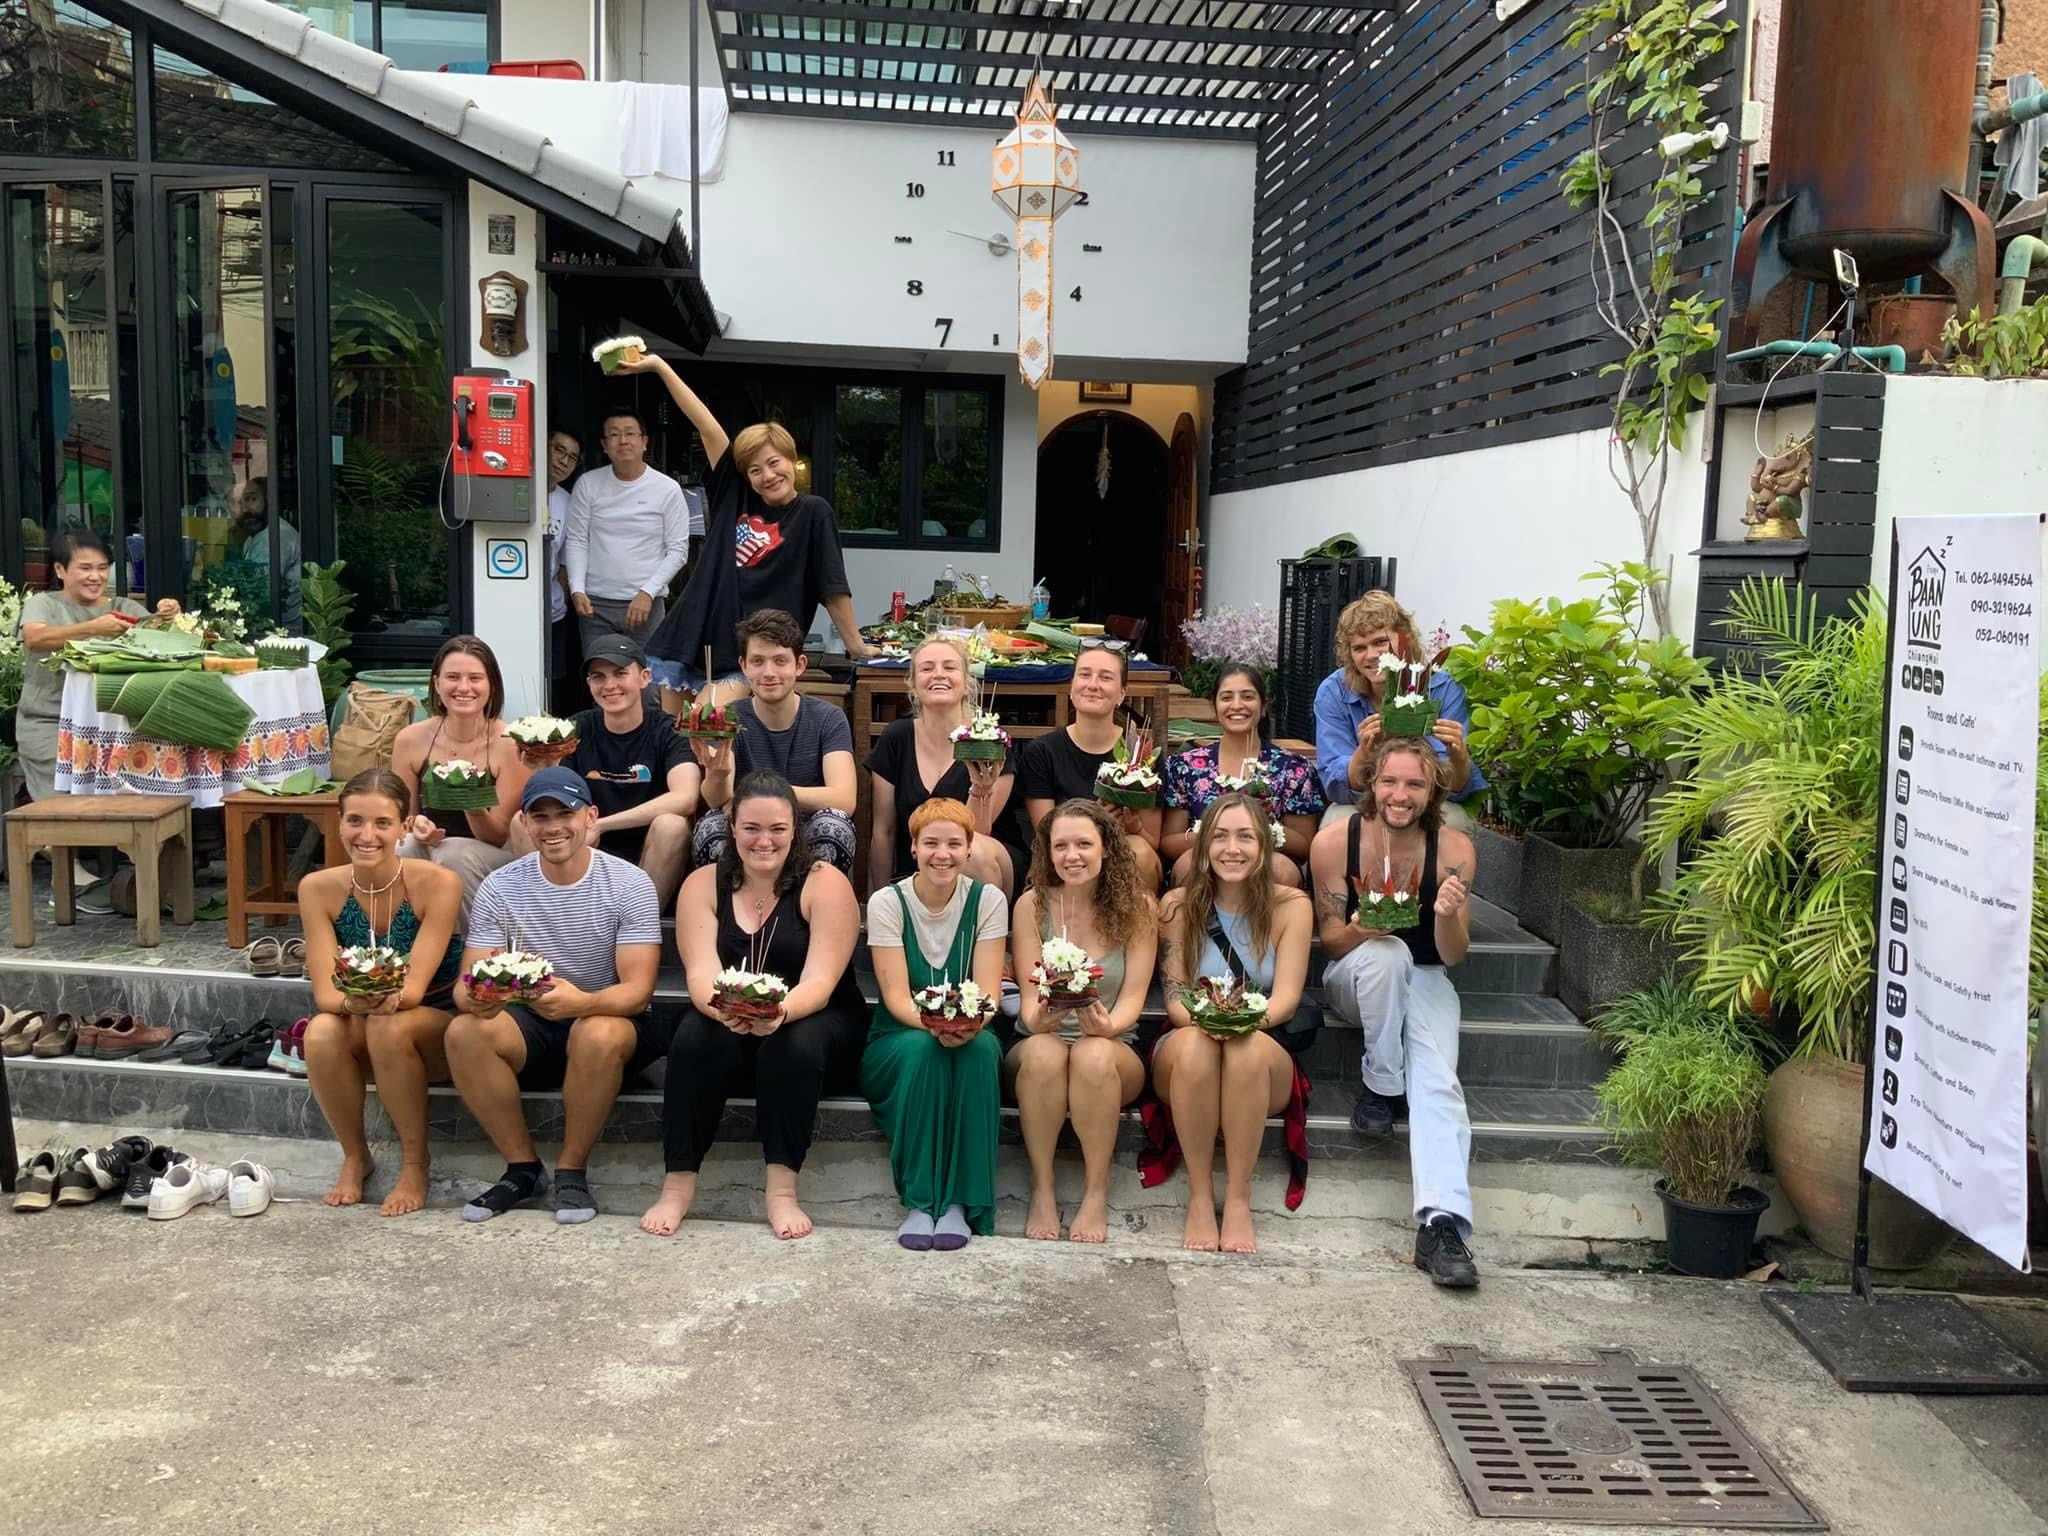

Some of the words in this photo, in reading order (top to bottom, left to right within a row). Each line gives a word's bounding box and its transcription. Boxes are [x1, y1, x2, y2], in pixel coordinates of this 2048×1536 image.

[937, 150, 956, 167] 11
[906, 182, 925, 198] 10
[1073, 192, 1089, 206] 2
[907, 279, 923, 296] 8
[1070, 286, 1082, 302] 4
[934, 317, 954, 348] 7
[1911, 566, 1942, 610] BAAN
[1912, 609, 1941, 641] UNG
[1726, 648, 1757, 670] BOX
